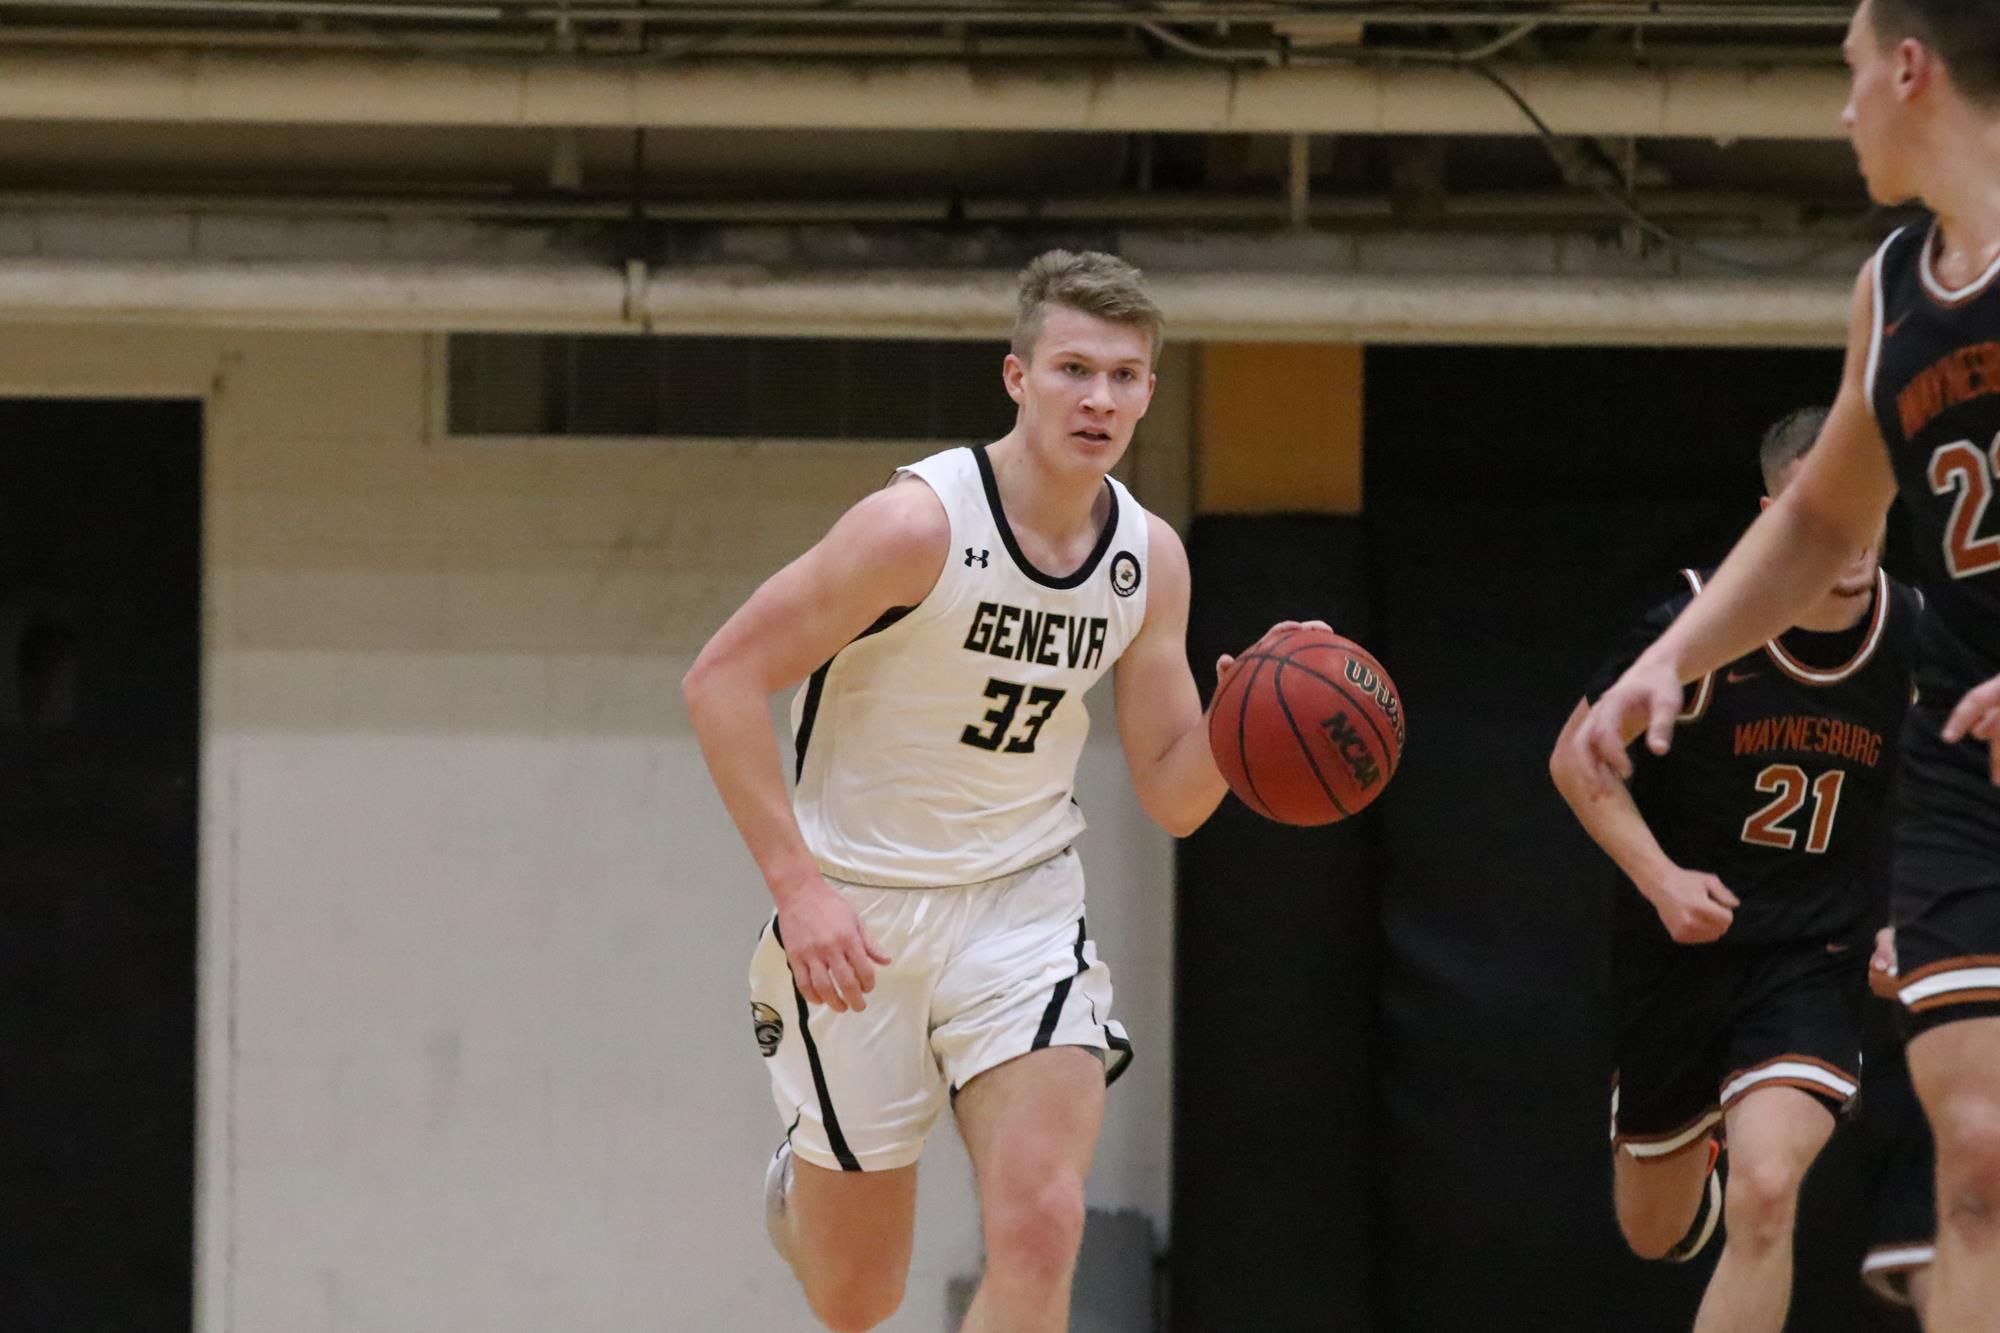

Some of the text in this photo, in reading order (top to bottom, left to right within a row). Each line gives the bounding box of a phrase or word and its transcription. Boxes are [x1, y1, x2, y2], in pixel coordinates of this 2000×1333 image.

[1927, 433, 2000, 578] 2
[963, 601, 1108, 670] GENEVA
[960, 677, 1066, 753] 33
[1322, 711, 1381, 791] NCAA
[1734, 715, 1882, 767] WAYNESBURG
[1741, 763, 1845, 854] 21
